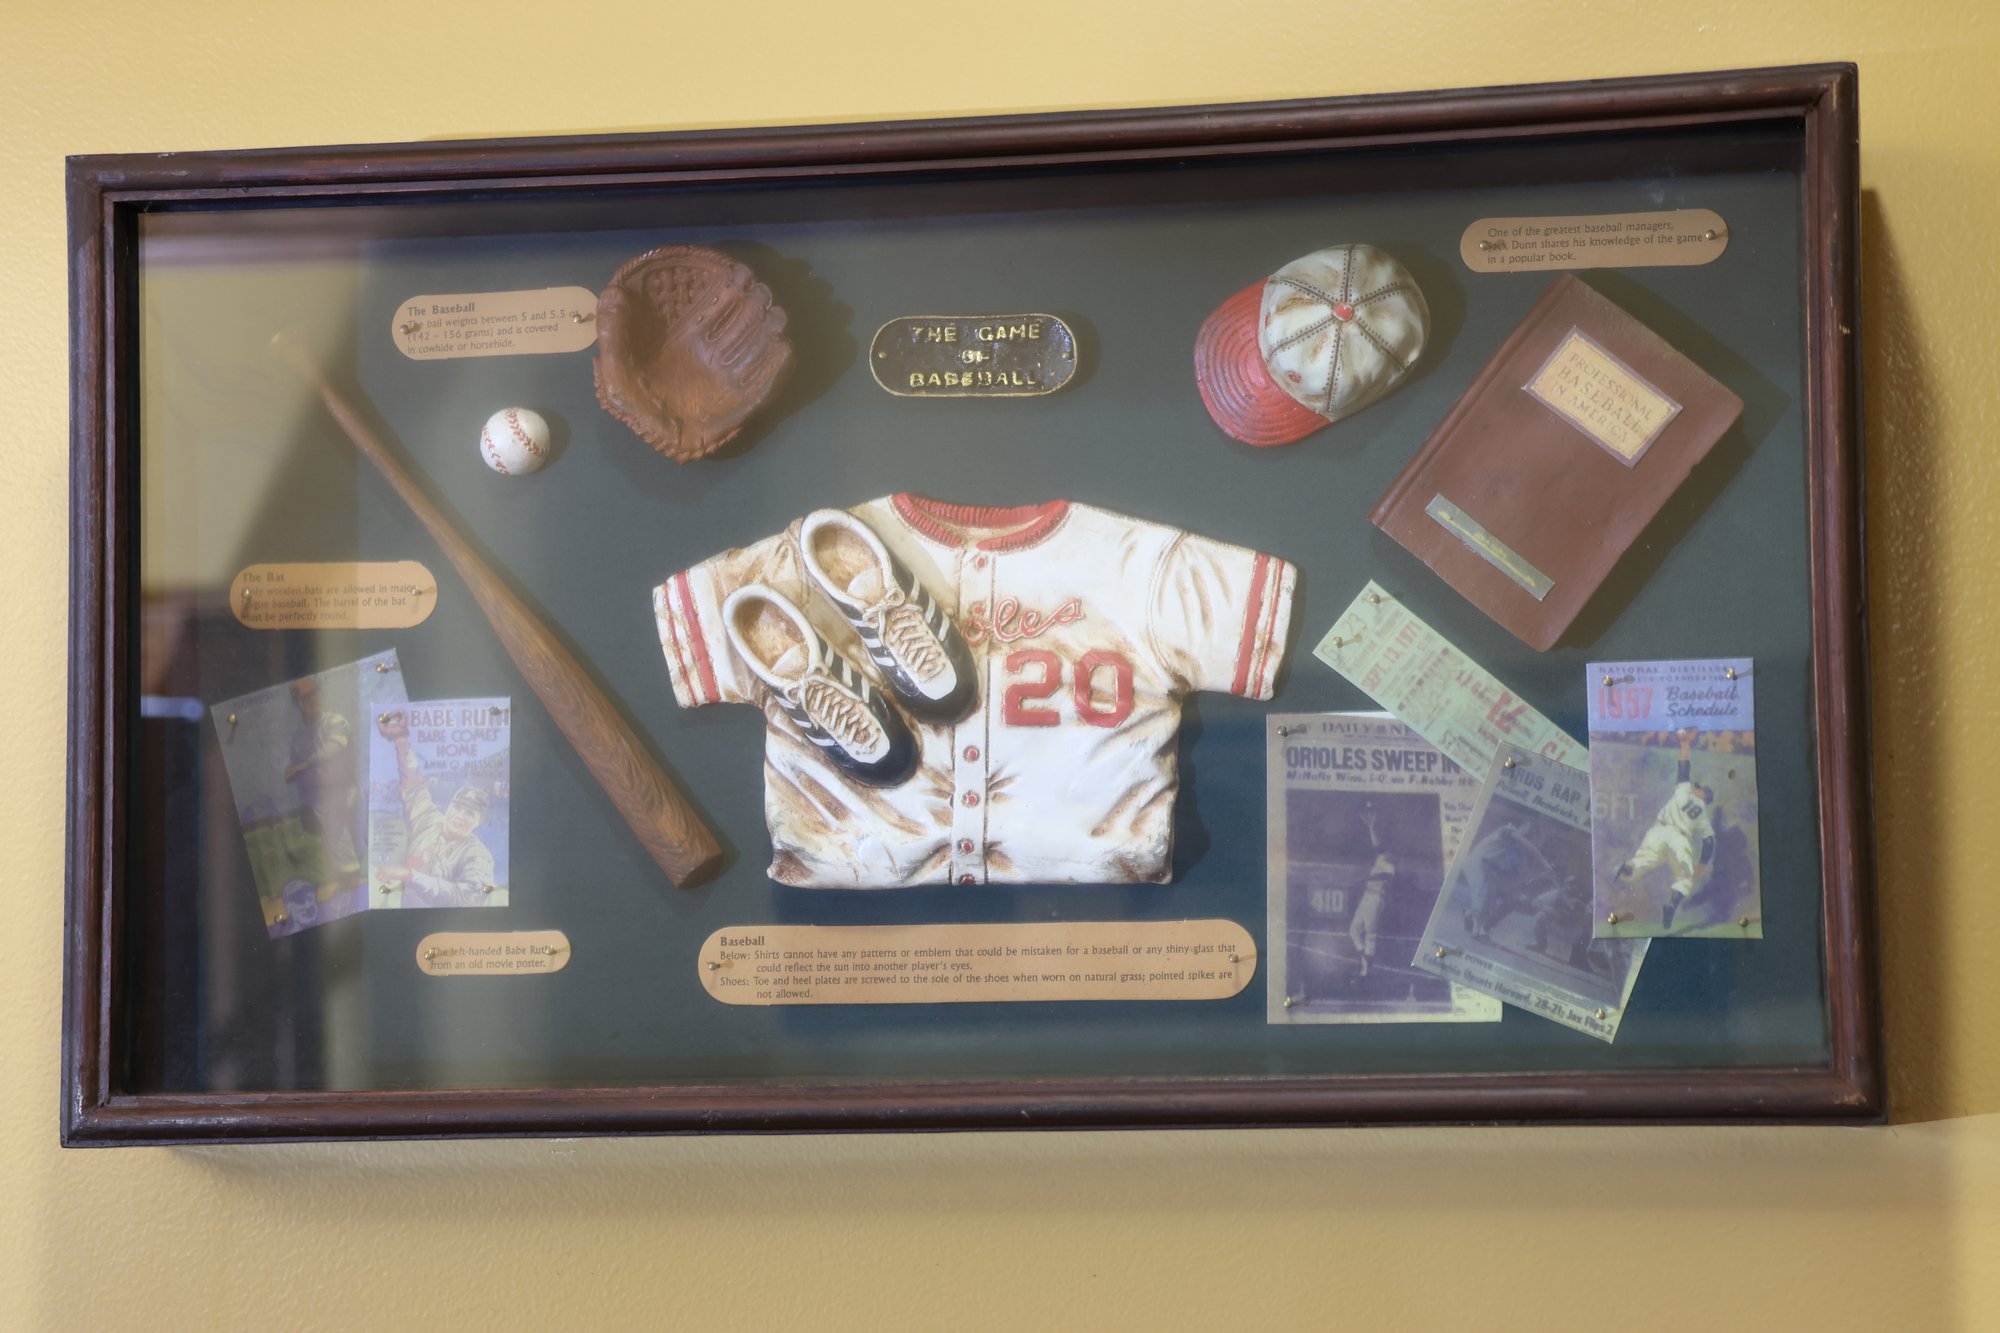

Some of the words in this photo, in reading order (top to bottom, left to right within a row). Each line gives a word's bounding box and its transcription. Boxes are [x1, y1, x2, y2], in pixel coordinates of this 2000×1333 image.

[1487, 227, 1509, 238] One
[1511, 226, 1523, 237] of
[1525, 225, 1541, 236] the
[1543, 225, 1581, 237] greatest
[1584, 223, 1622, 234] baseball
[1626, 221, 1674, 233] managers,
[1511, 240, 1537, 250] Dunn
[1540, 238, 1570, 249] shares
[1572, 237, 1586, 247] his
[1589, 235, 1641, 248] knowledge
[1644, 233, 1656, 244] of
[1658, 233, 1673, 244] the
[1676, 234, 1703, 245] game
[1487, 254, 1496, 264] in
[1508, 253, 1545, 265] popular
[1549, 251, 1576, 262] book.
[407, 306, 427, 317] The
[431, 302, 476, 316] Baseball
[426, 318, 442, 328] ball
[445, 315, 478, 329] weights
[480, 313, 519, 325] between
[521, 311, 527, 322] 5
[530, 311, 547, 321] and
[550, 309, 566, 320] 5.5
[407, 330, 430, 342] (142
[443, 329, 462, 340] 156
[464, 326, 494, 339] grams)
[497, 324, 513, 335] and
[515, 324, 522, 334] is
[524, 322, 558, 333] covered
[912, 326, 957, 343] THE
[977, 323, 1040, 342] GAME
[418, 342, 454, 354] cowhide
[457, 343, 467, 351] or
[470, 339, 516, 350] horsehide.
[909, 370, 1036, 388] BASEBALL
[1569, 354, 1653, 420] PROFESSIONAL
[1558, 366, 1641, 432] BASEBALL
[243, 572, 262, 583] The
[267, 571, 285, 582] Bat
[267, 584, 301, 595] wooden
[304, 583, 323, 595] bats
[326, 586, 340, 595] are
[343, 582, 376, 594] allowed
[379, 582, 388, 593] in
[272, 598, 310, 609] baseball.
[314, 597, 330, 608] The
[333, 596, 359, 607] barrel
[362, 595, 373, 606] of
[374, 595, 389, 606] the
[391, 595, 406, 605] bat
[265, 611, 276, 621] be
[279, 609, 318, 623] perfectly
[320, 609, 349, 620] round.
[1003, 649, 1134, 728] 20
[1665, 685, 1738, 701] Baseball
[1597, 687, 1653, 720] 1957
[1665, 702, 1738, 717] Schedule
[410, 709, 456, 728] BABE
[461, 707, 510, 727] RUTH
[417, 730, 449, 743] BABE
[451, 728, 499, 742] COMES
[436, 744, 478, 757] HOME
[1286, 746, 1367, 770] ORIOLES
[1371, 749, 1438, 773] SWEEP
[1441, 753, 1462, 774] IN
[1550, 782, 1581, 805] RAP
[1311, 889, 1344, 913] 410
[720, 936, 765, 947] Baseball
[450, 945, 504, 957] left-handed
[505, 945, 527, 956] Babe
[720, 950, 750, 961] Below:
[754, 950, 780, 960] Shirts
[783, 951, 814, 959] cannot
[817, 949, 838, 959] have
[841, 951, 858, 961] any
[860, 949, 897, 961] patterns
[900, 950, 910, 958] or
[914, 948, 951, 957] emblem
[955, 948, 974, 957] that
[977, 947, 1002, 957] could
[1006, 947, 1018, 956] be
[1021, 946, 1062, 957] mistaken
[1066, 945, 1079, 955] for
[1092, 944, 1128, 955] baseball
[1146, 946, 1163, 956] any
[1217, 943, 1236, 953] that
[430, 960, 452, 970] from
[455, 961, 466, 969] an
[468, 959, 483, 969] old
[486, 958, 514, 969] movie
[516, 959, 546, 972] poster.
[756, 963, 781, 973] could
[784, 962, 813, 972] reflect
[816, 962, 831, 972] the
[834, 964, 849, 972] sun
[852, 962, 870, 971] into
[873, 961, 907, 971] another
[911, 960, 947, 972] player's
[950, 962, 973, 972] eyes.
[720, 976, 750, 986] Shoes:
[754, 976, 769, 986] Toe
[772, 976, 789, 985] and
[792, 975, 812, 985] heel
[815, 974, 841, 986] plates
[861, 974, 897, 984] screwed
[900, 974, 910, 983] to
[913, 973, 928, 983] the
[931, 973, 949, 983] sole
[952, 972, 964, 983] of
[966, 973, 981, 983] the
[984, 972, 1010, 982] shoes
[1013, 972, 1039, 982] when
[1042, 973, 1066, 981] worn
[1084, 971, 1117, 981] natural
[1120, 972, 1146, 984] grass;
[1149, 970, 1185, 983] pointed
[1188, 970, 1216, 982] spikes
[1218, 971, 1234, 979] are
[756, 989, 772, 999] not
[775, 988, 814, 999] allowed.
